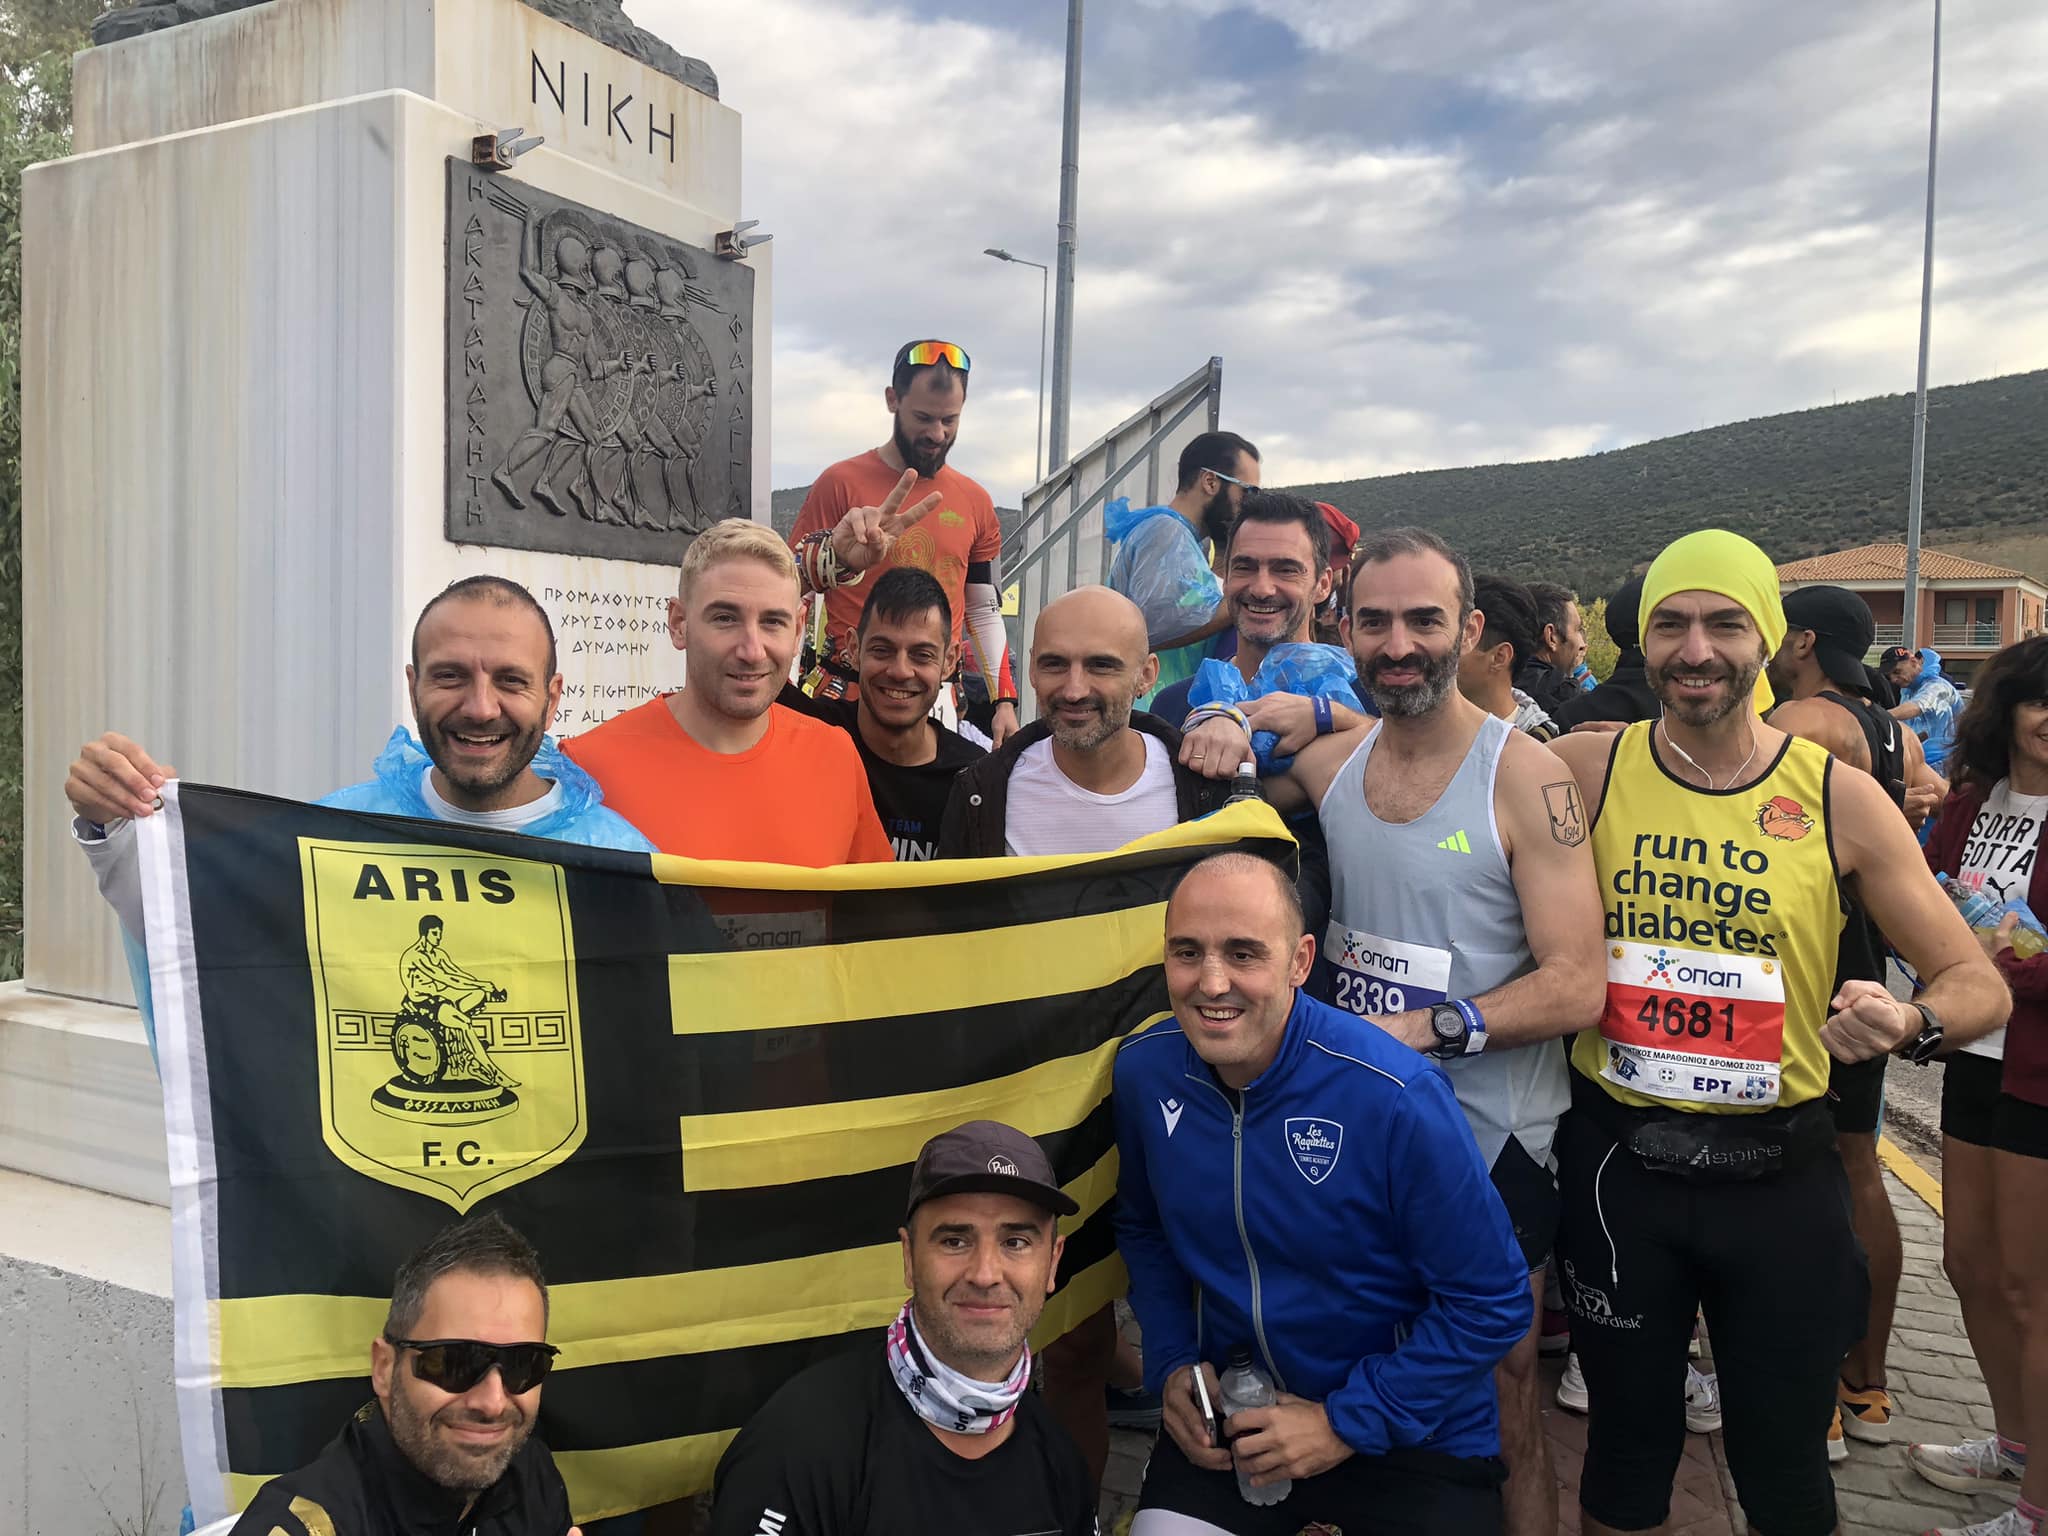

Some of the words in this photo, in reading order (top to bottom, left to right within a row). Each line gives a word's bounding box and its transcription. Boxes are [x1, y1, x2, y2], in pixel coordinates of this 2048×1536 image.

[531, 49, 675, 163] ΝΙΚΗ
[728, 313, 745, 511] ΦΑΛΑΓΓΑ
[572, 640, 650, 656] ΔΥΝΑΜΗΝ
[593, 684, 661, 699] FIGHTING
[582, 709, 608, 723] ALL
[1633, 833, 1708, 865] run
[1720, 839, 1769, 875] to
[1960, 840, 2036, 877] GOTTA
[353, 863, 516, 905] ARIS
[1613, 859, 1772, 918] change
[1335, 971, 1405, 1016] 2339
[1637, 995, 1735, 1042] 4681
[1709, 1059, 1745, 1070] ΔΡΟΜΟΣ
[1745, 1063, 1765, 1072] 2023
[1292, 1132, 1335, 1151] Raquettes
[1307, 1123, 1322, 1137] Les
